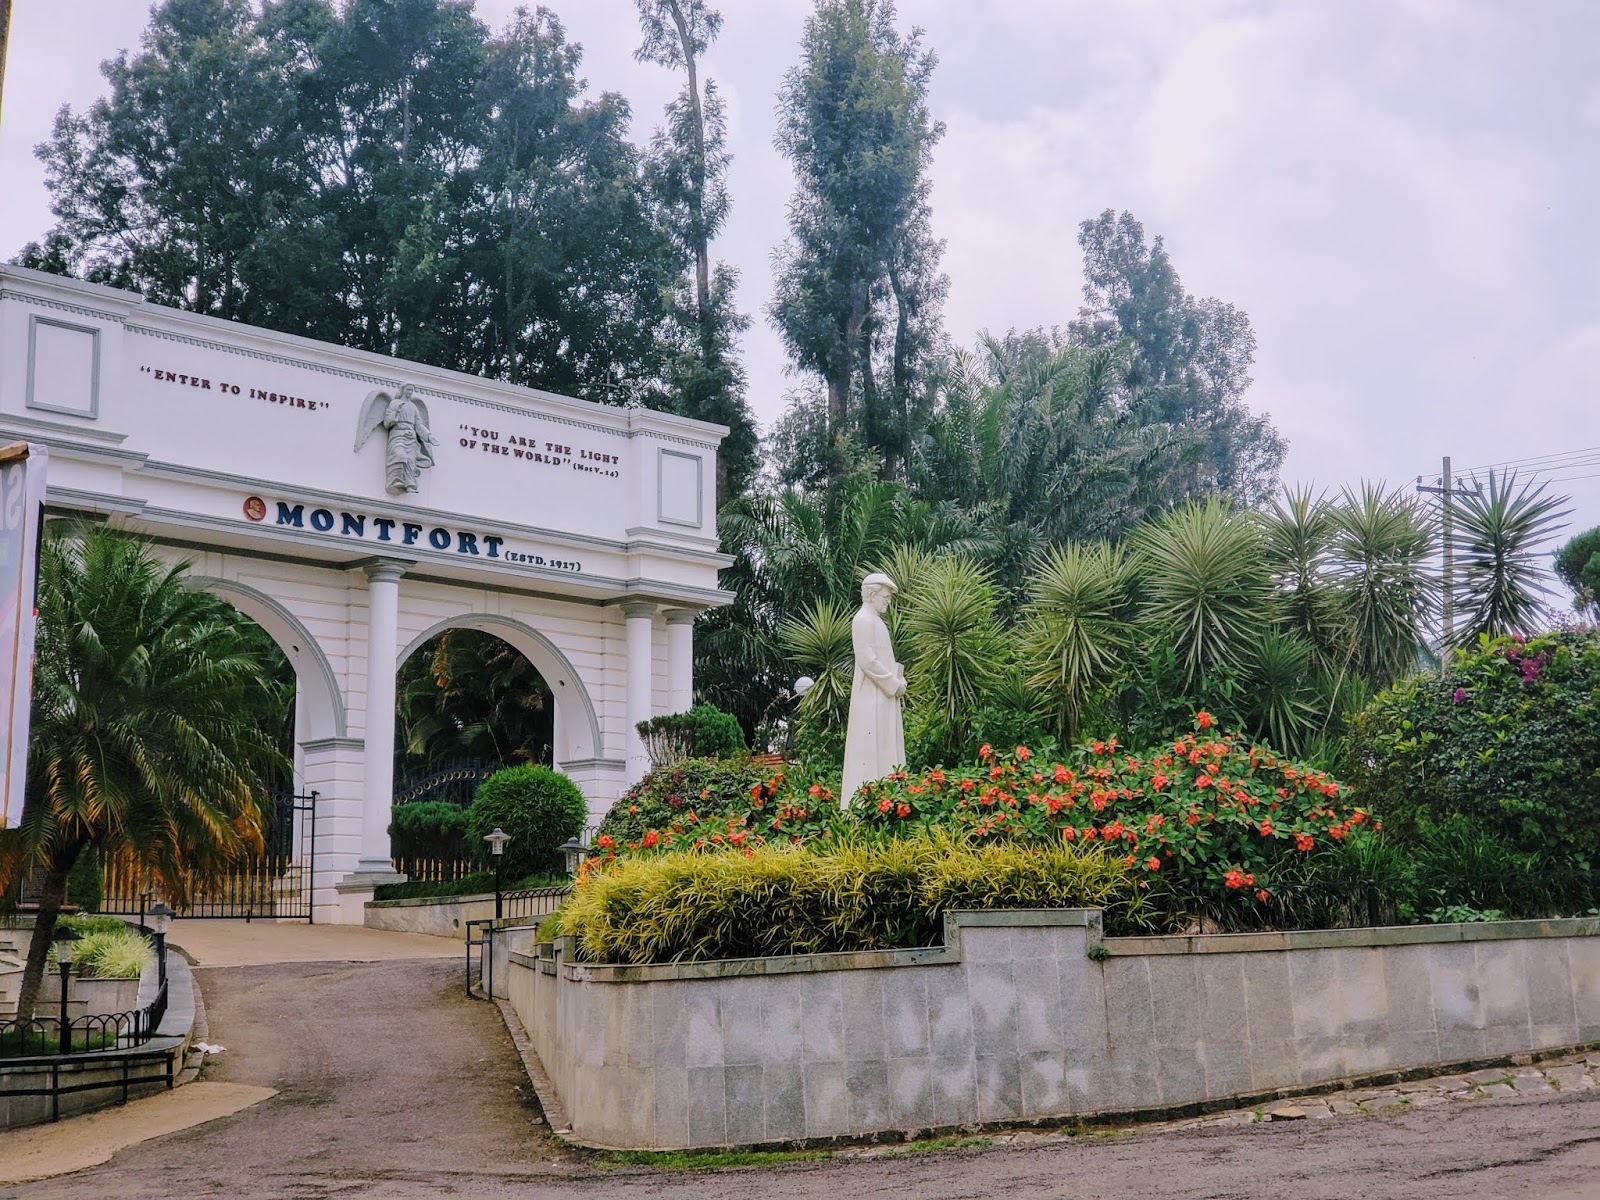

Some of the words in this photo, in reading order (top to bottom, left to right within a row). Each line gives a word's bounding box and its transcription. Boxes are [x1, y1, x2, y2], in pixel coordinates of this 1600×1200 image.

[140, 365, 211, 390] “ENTER
[220, 383, 241, 395] TO
[249, 388, 330, 411] INSPIRE”
[459, 424, 499, 440] “YOU
[508, 435, 536, 448] ARE
[546, 442, 572, 455] THE
[580, 450, 619, 465] LIGHT
[459, 438, 477, 449] OF
[482, 442, 509, 456] THE
[513, 448, 571, 466] WORLD”
[276, 502, 504, 557] MONTFORT
[505, 551, 547, 566] (ESTD.
[550, 559, 582, 572] 1917)
